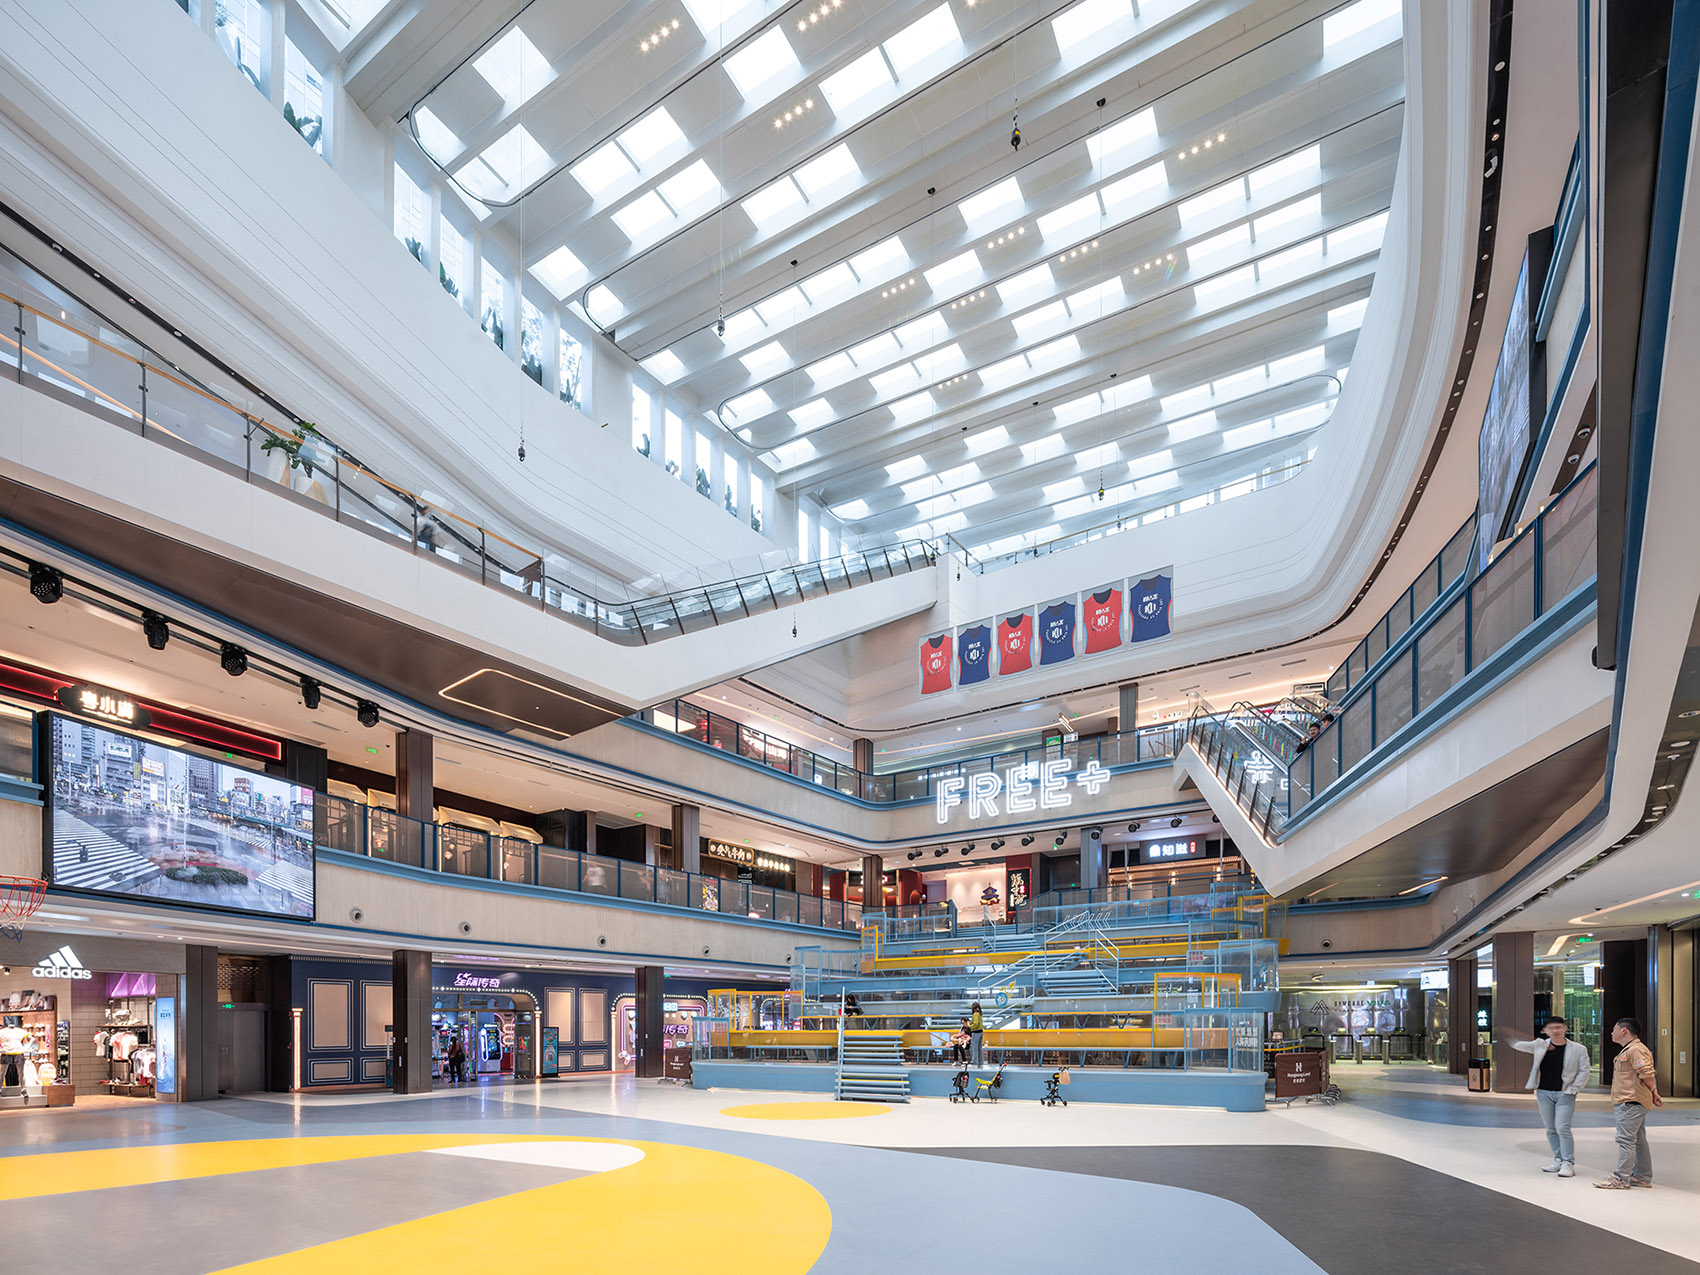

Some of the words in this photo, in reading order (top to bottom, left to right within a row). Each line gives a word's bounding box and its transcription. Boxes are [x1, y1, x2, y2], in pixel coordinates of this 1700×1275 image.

[936, 758, 1111, 824] FREE+
[32, 965, 92, 980] adidas
[453, 972, 501, 988] 星际传奇
